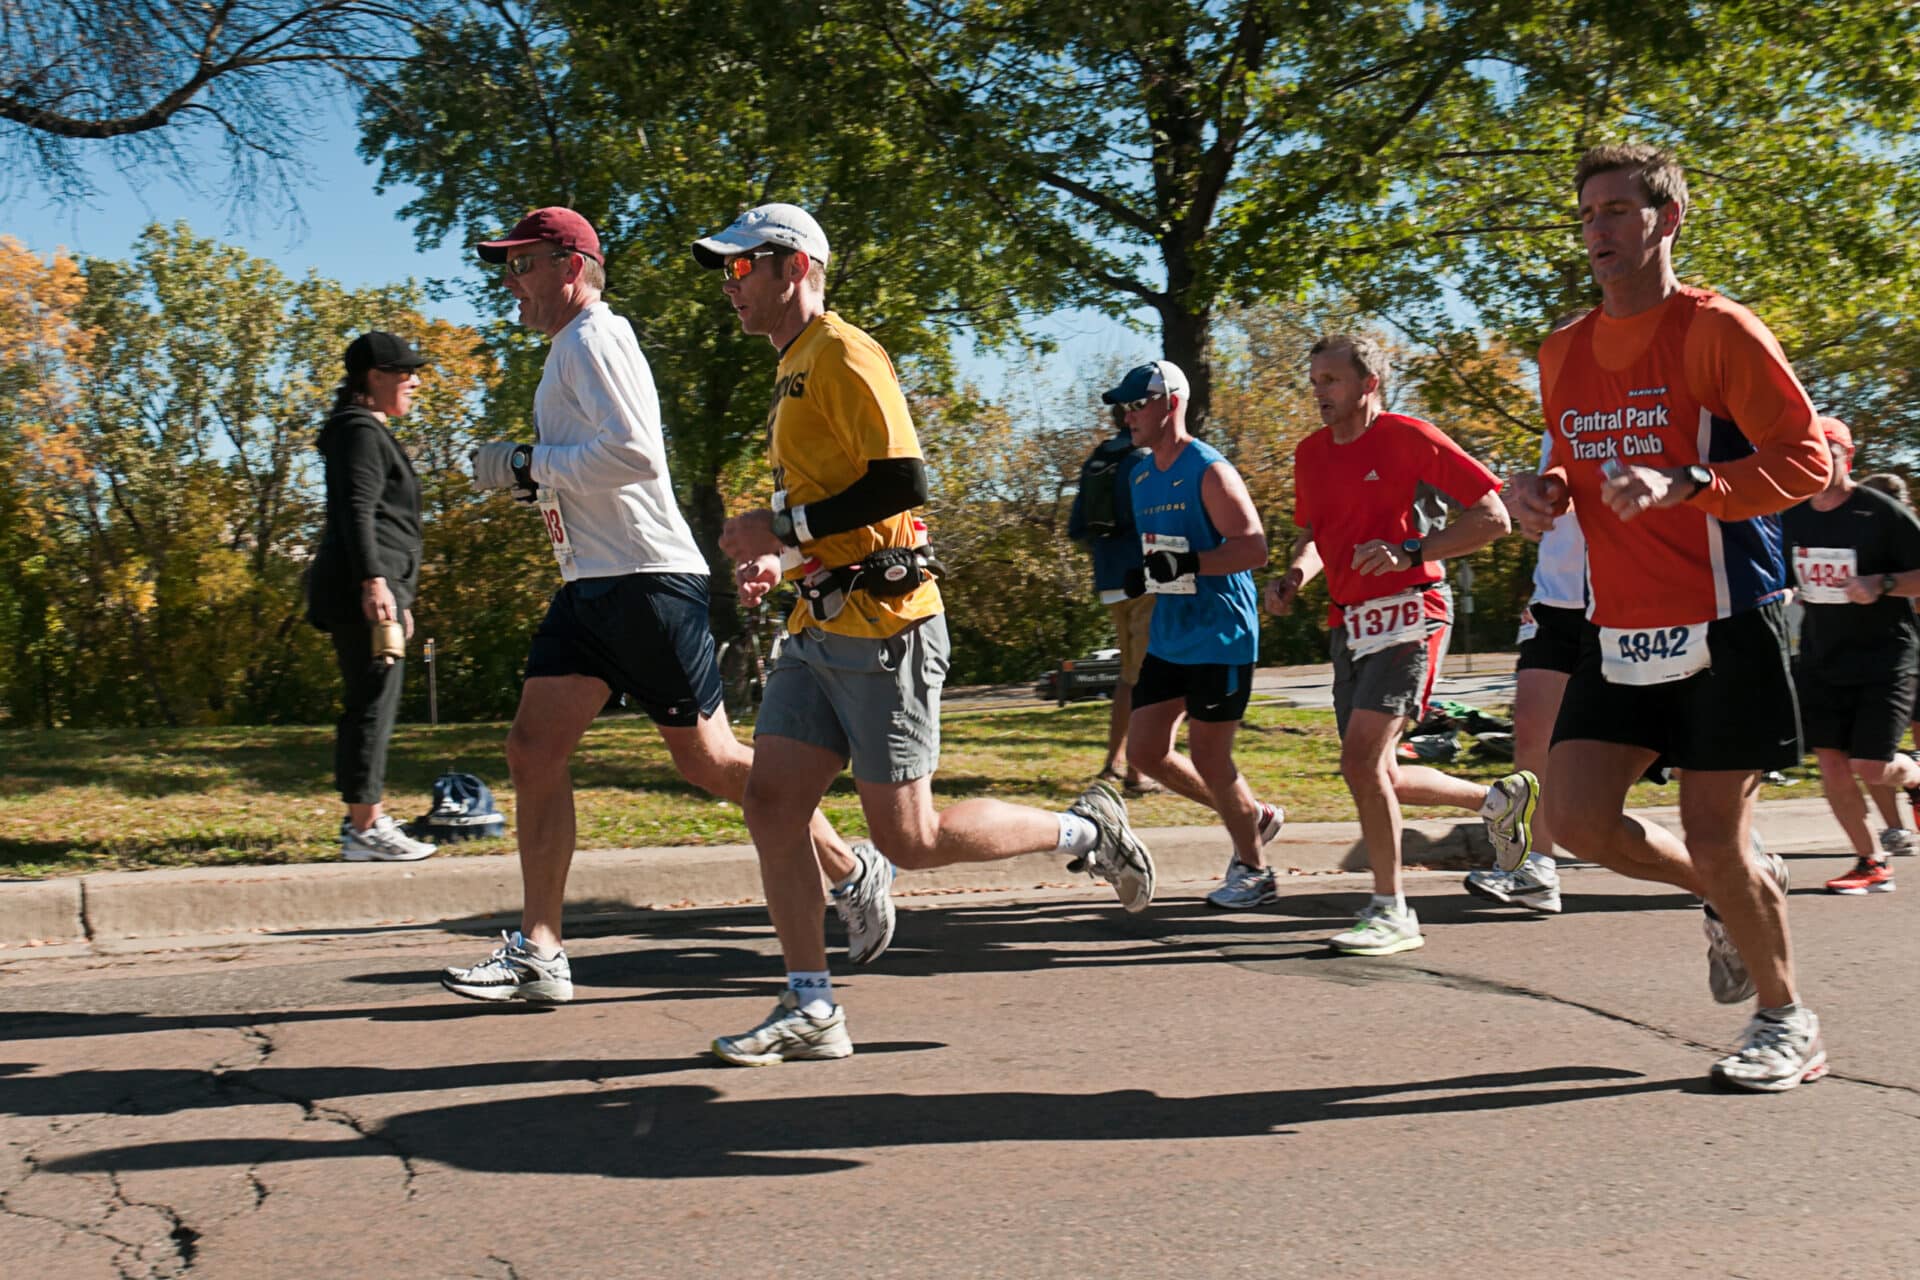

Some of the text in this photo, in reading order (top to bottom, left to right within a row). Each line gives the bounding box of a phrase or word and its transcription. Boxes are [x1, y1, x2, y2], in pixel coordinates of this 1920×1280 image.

[1560, 404, 1669, 438] Central Park
[1570, 434, 1664, 460] Track Club
[1349, 601, 1419, 639] 1376
[1618, 626, 1690, 662] 4842
[793, 977, 828, 988] 26.2
